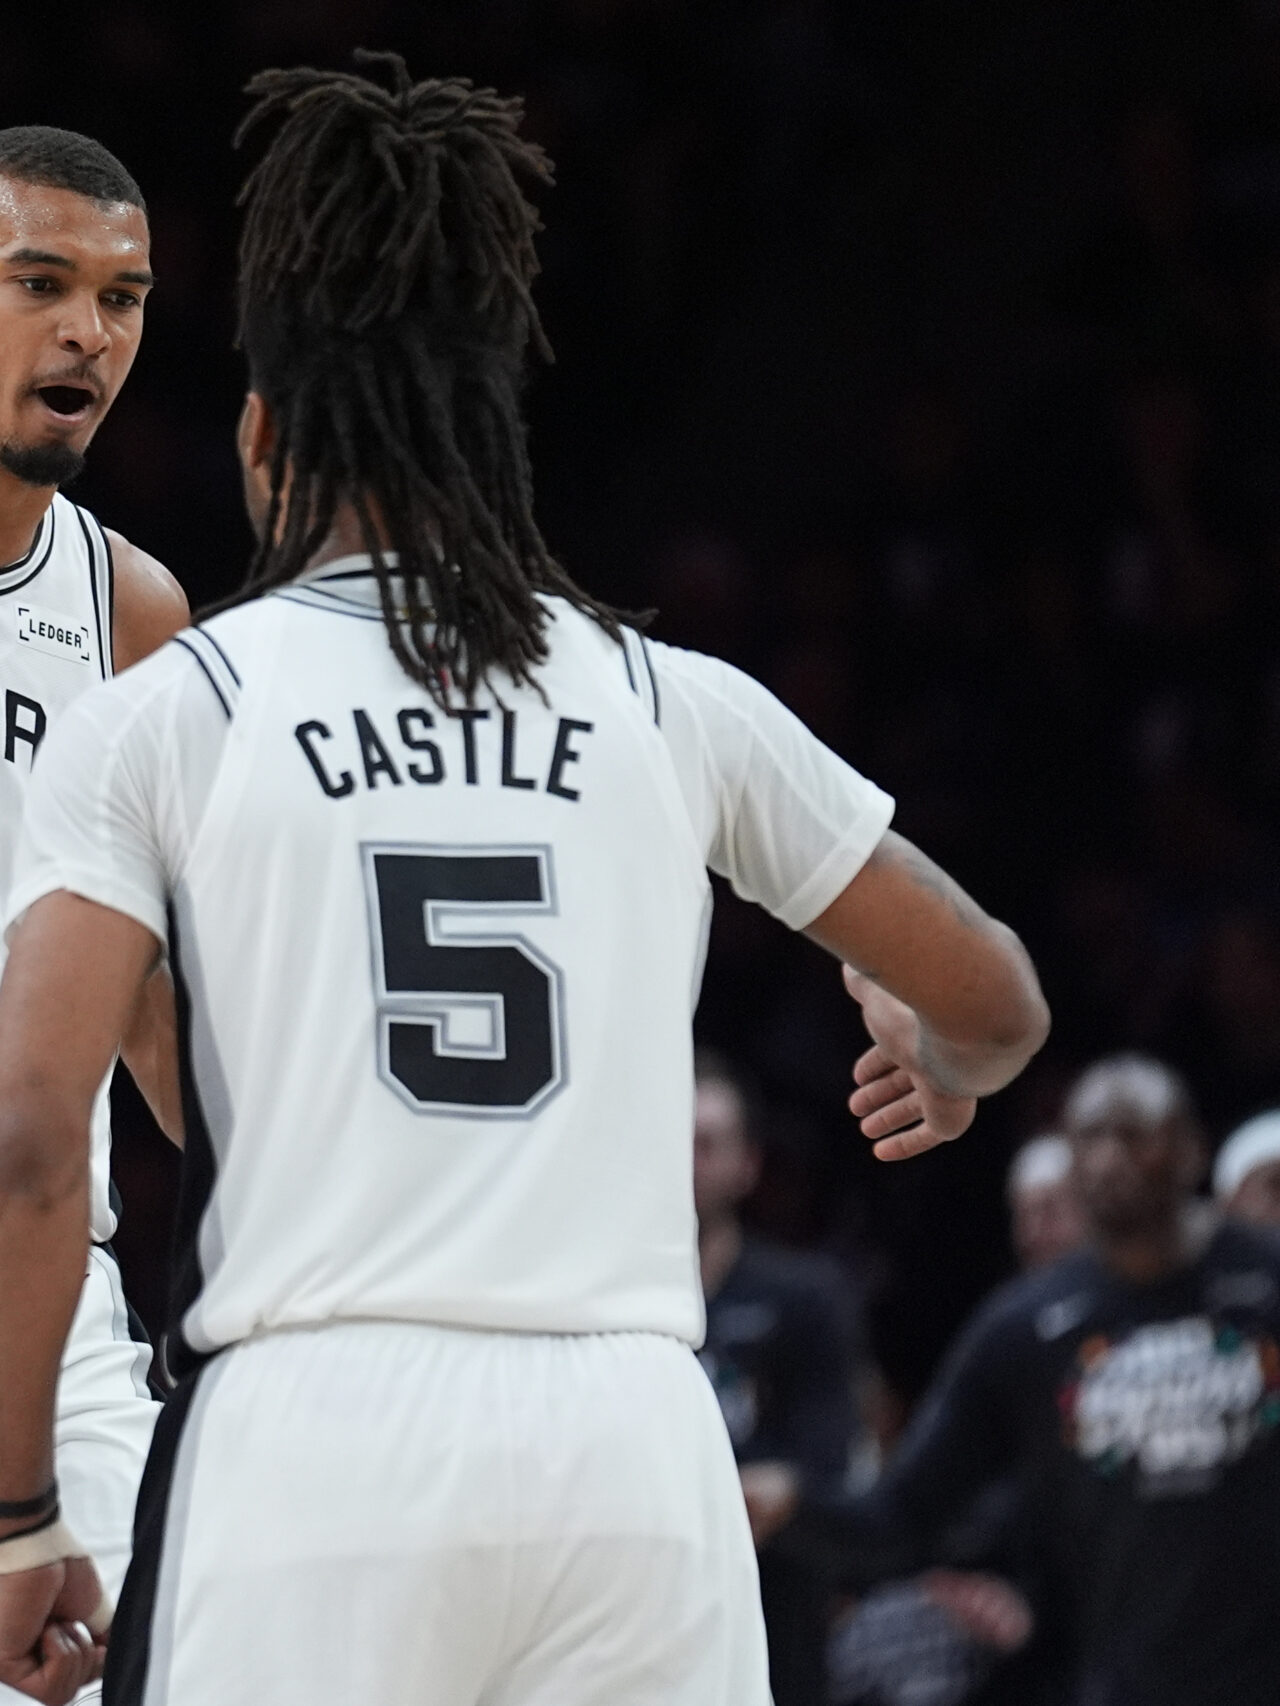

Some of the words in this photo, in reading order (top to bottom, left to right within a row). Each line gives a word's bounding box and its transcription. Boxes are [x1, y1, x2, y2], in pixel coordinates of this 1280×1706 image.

[29, 618, 82, 649] LEDGER
[294, 708, 594, 802] CASTLE
[359, 841, 570, 1121] 5
